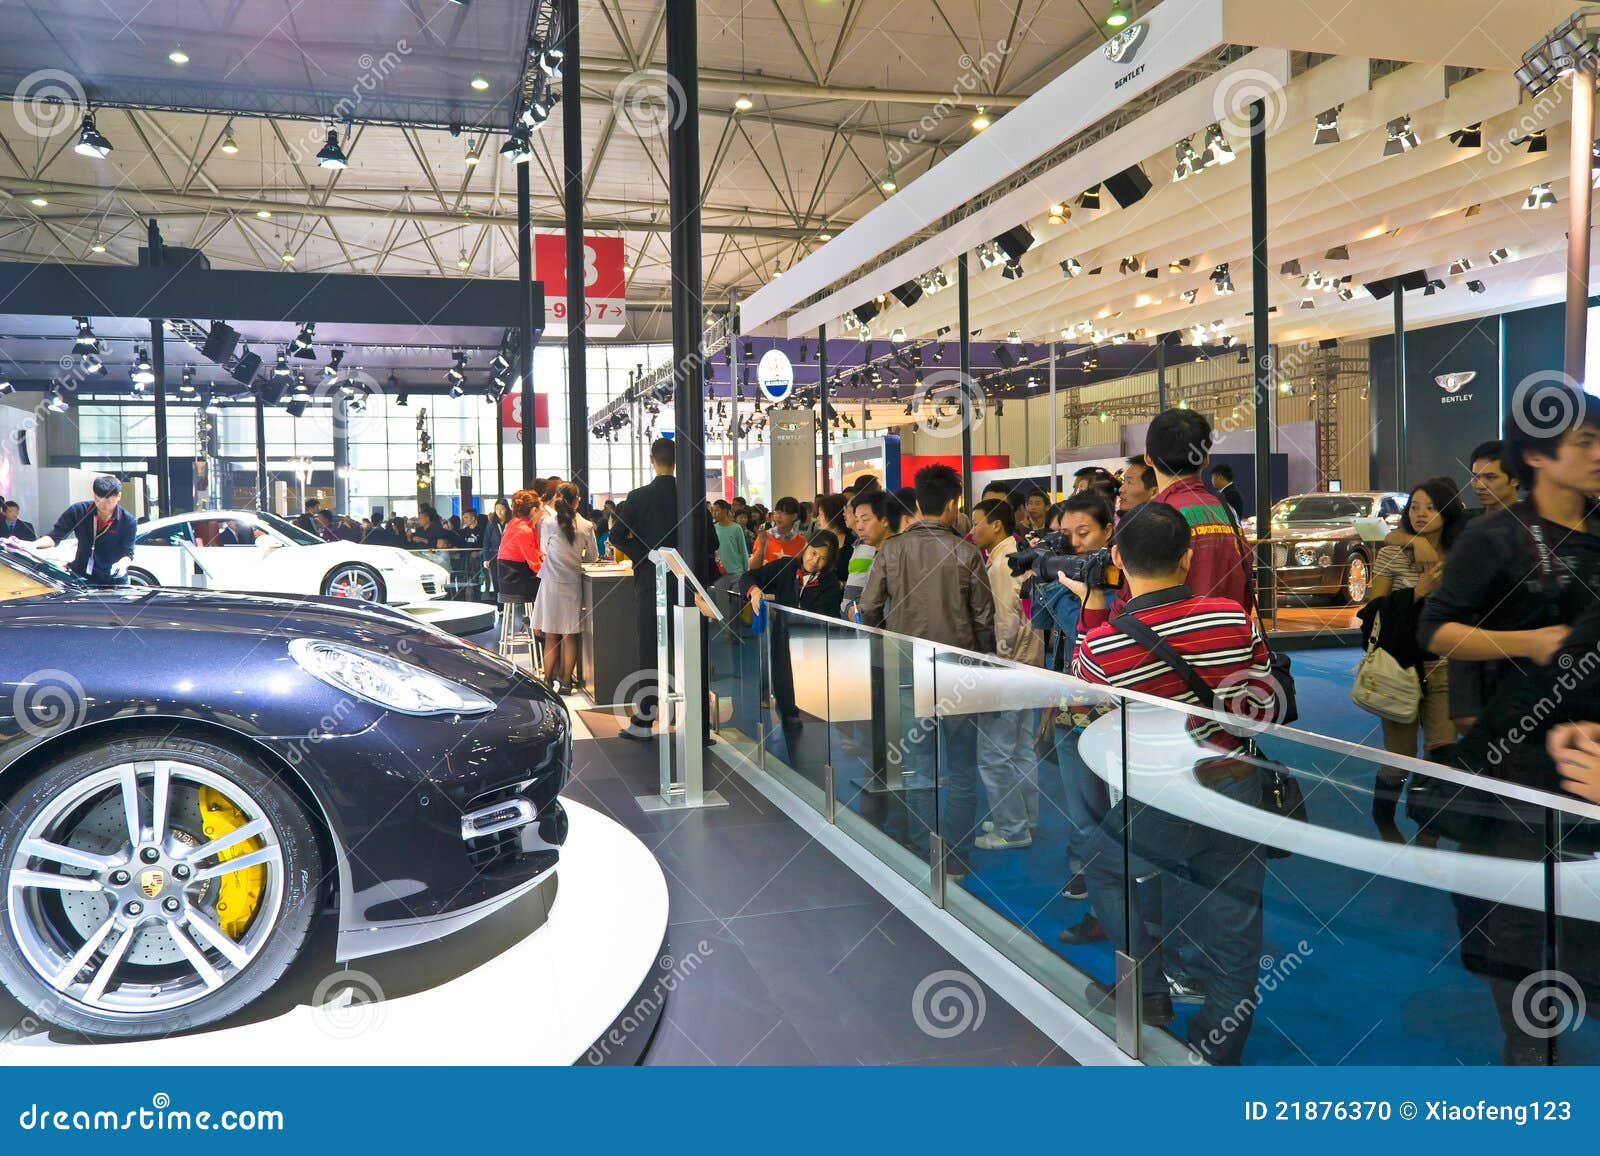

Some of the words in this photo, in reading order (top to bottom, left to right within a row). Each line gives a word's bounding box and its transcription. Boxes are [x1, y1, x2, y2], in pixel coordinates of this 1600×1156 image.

[1114, 64, 1146, 89] BENTLEY
[595, 303, 608, 319] 7
[1441, 393, 1473, 404] BENTLEY
